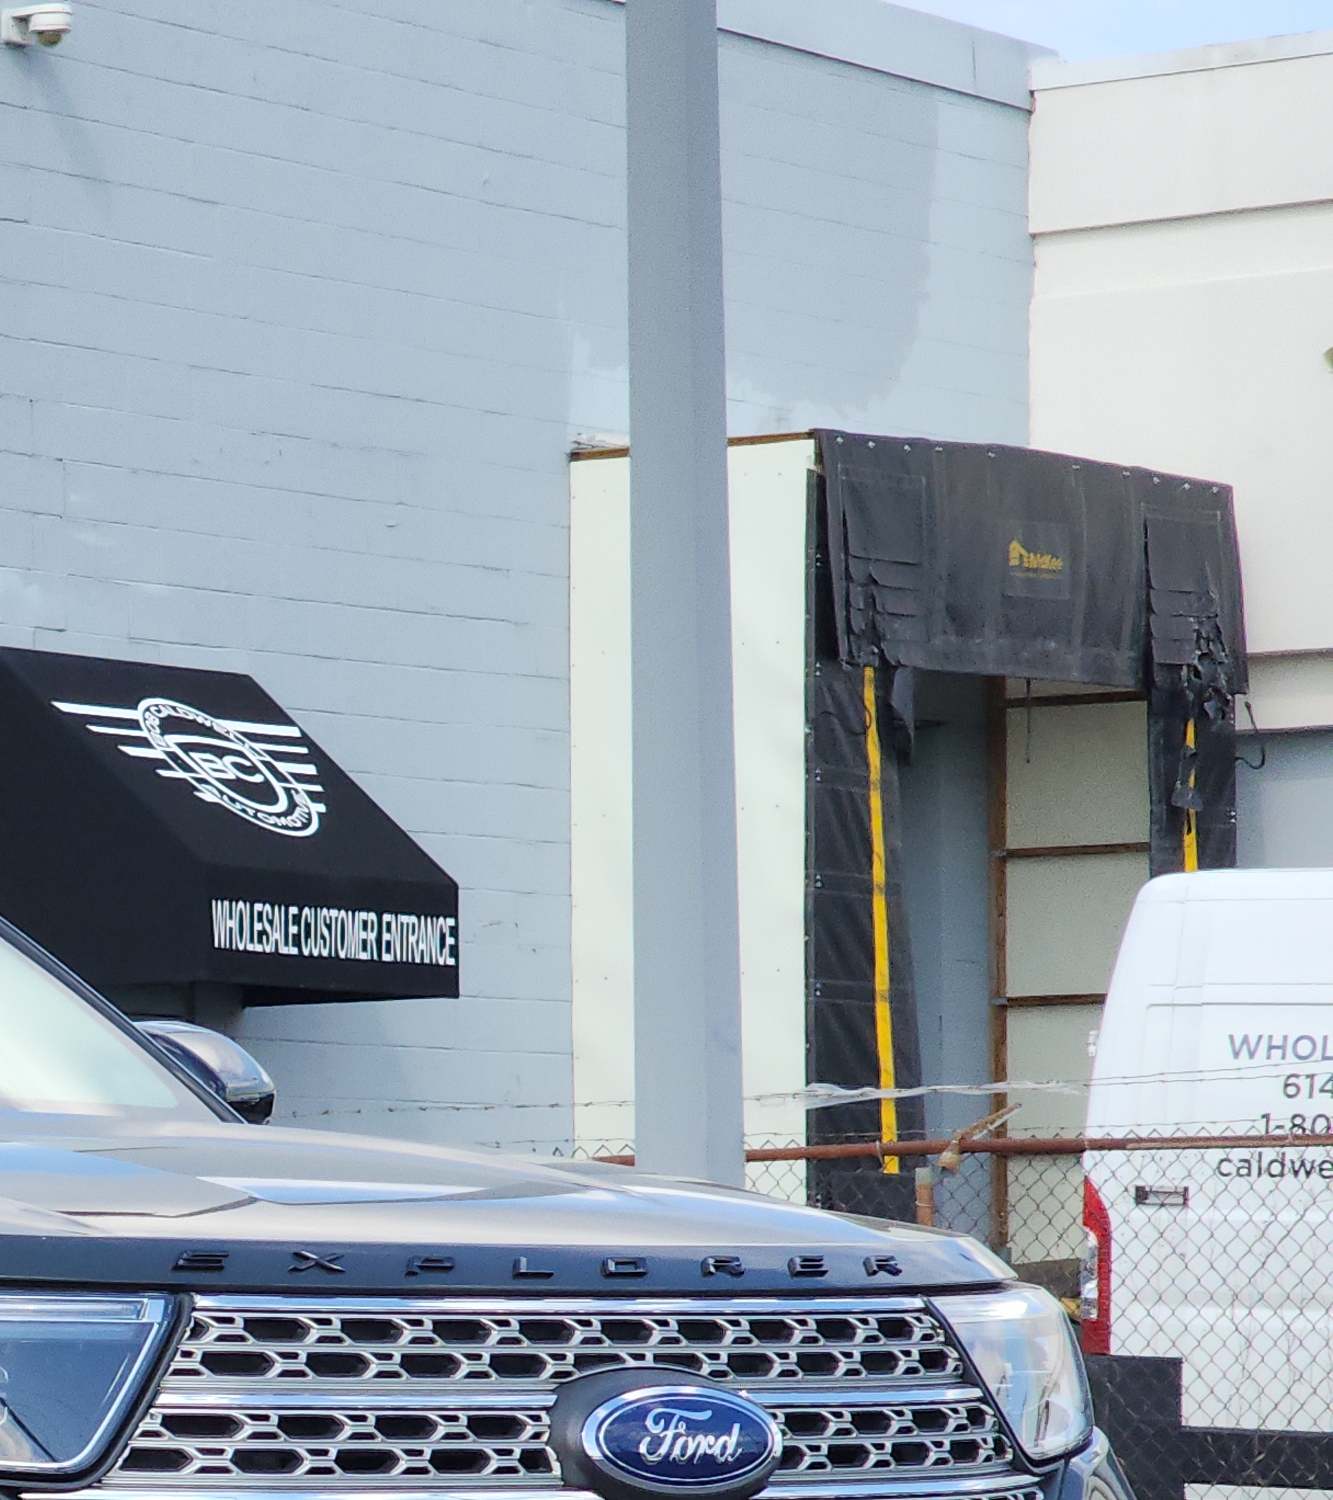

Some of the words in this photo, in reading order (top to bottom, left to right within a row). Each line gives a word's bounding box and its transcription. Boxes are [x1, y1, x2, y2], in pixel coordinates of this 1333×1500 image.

[145, 711, 169, 748] BOB
[189, 751, 265, 783] BC
[212, 899, 299, 955] WHOLESALE
[300, 907, 379, 961] CUSTOMER
[382, 912, 457, 966] ENTRANCE
[1228, 1034, 1333, 1061] WHOL
[1283, 1073, 1333, 1099] 614
[1217, 1151, 1333, 1179] caldwe
[172, 1249, 903, 1280] EXPLORER
[639, 1408, 743, 1465] Ford
